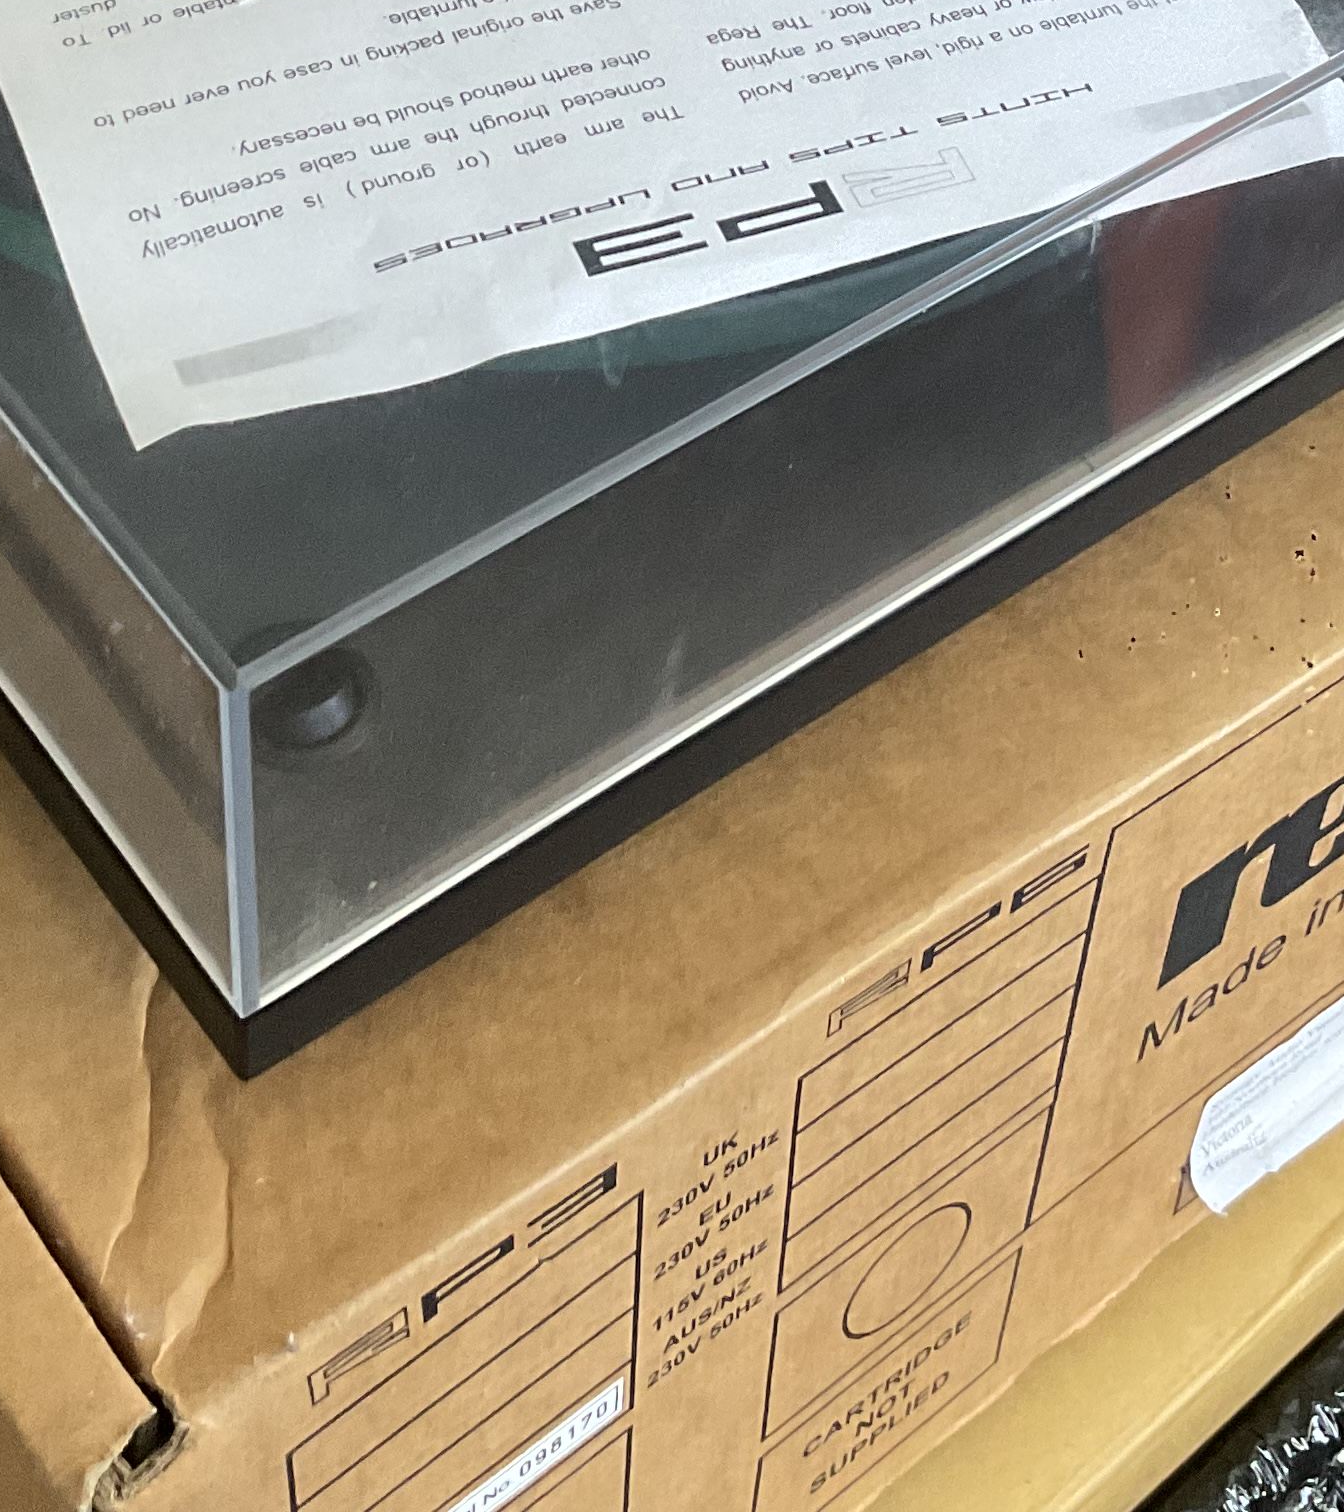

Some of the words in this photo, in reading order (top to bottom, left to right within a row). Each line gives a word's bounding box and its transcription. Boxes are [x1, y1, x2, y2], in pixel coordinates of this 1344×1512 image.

[769, 14, 814, 32] The
[838, 18, 922, 48] cabinets
[927, 2, 989, 28] heavy
[1006, 22, 1035, 38] on
[1036, 1, 1124, 32] turntable
[704, 22, 763, 46] Rega
[813, 38, 835, 54] or
[986, 29, 1004, 43] a
[719, 43, 807, 73] anything
[882, 46, 934, 71] level
[558, 75, 667, 114] connected
[735, 76, 794, 105] Avoid
[933, 82, 1095, 128] HINTS
[467, 102, 551, 136] through
[581, 116, 626, 138] arm
[639, 103, 686, 124] The
[367, 136, 412, 157] arm
[422, 125, 460, 145] the
[511, 131, 568, 157] earth
[784, 123, 919, 164] TIPS
[297, 148, 358, 174] cable
[668, 157, 772, 193] AND
[126, 202, 163, 224] No
[301, 191, 324, 209] is
[569, 145, 978, 277] RP3
[140, 203, 285, 260] automatically
[370, 187, 652, 274] UPGRADES
[1135, 921, 1291, 1064] Made
[701, 1129, 739, 1171] UK
[656, 1171, 716, 1227] 230V
[722, 1125, 780, 1181] 50Hz
[697, 1189, 732, 1228] EU
[653, 1225, 711, 1282] 230V
[717, 1179, 776, 1235] 50Hz
[693, 1245, 728, 1283] US
[307, 1160, 618, 1407] RP3
[651, 1278, 709, 1335] 115V
[712, 1233, 769, 1289] 60Hz
[663, 1273, 753, 1356] AUS/NZ
[646, 1332, 706, 1390] 230V
[709, 1287, 764, 1342] 50Hz
[801, 1308, 973, 1461] CARTRIDGE
[854, 1376, 916, 1439] NOT
[519, 1401, 607, 1477] 098170
[808, 1366, 951, 1496] SUPPLIED
